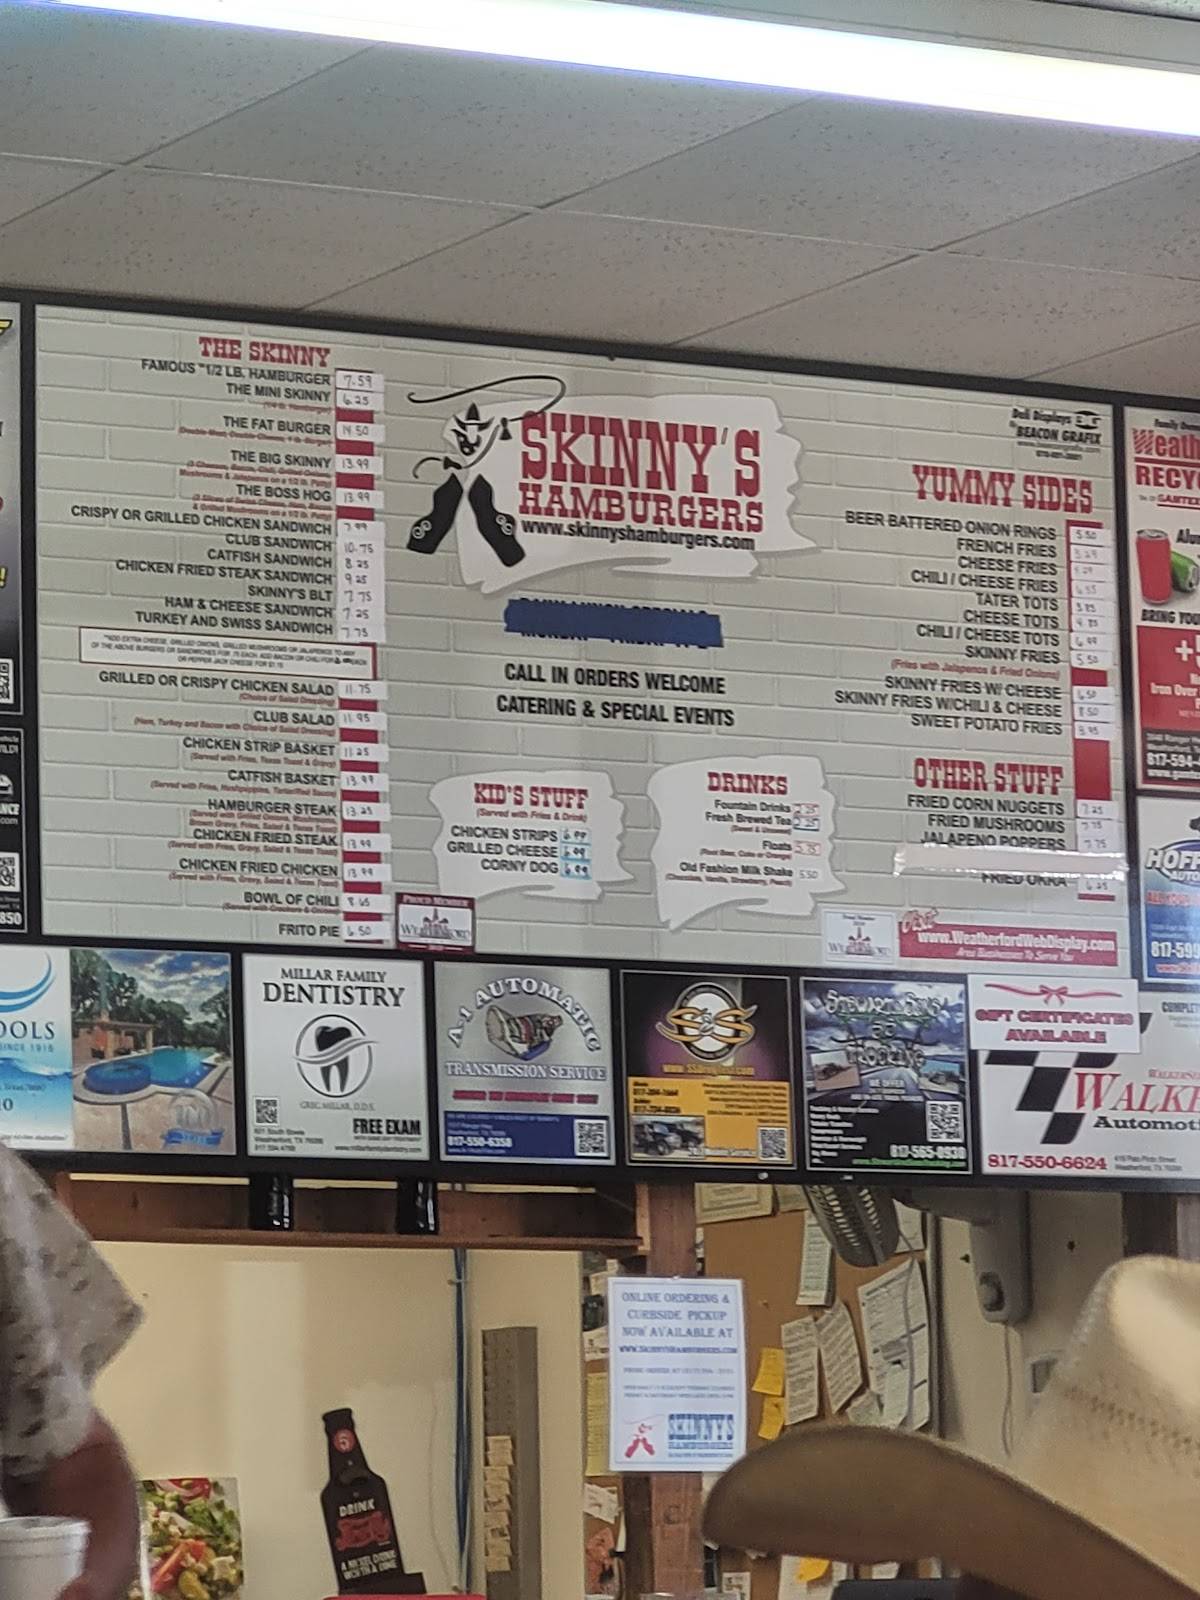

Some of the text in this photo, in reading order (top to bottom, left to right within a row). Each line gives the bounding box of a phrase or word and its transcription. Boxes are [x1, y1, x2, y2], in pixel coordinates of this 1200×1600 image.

[199, 337, 330, 367] THE SKINNY
[141, 359, 330, 386] FAMOUS HAMBURGER
[226, 383, 330, 402] THE MINI SKINNY
[223, 416, 330, 436] THE FAT BURGER
[1017, 426, 1102, 445] BEACON GRAFIX
[230, 450, 330, 468] THE BIG SKINNY
[521, 410, 761, 497] SKINNY'S
[236, 484, 331, 502] THE BOSS HOG
[912, 464, 1094, 514] YUMMY SIDES
[518, 482, 764, 533] HAMBURGERS
[71, 506, 331, 535] CRISPY OR GRILLED CHICKEN SANDWICH
[845, 511, 1056, 540] BEER BATTERED ONION RINGS
[225, 534, 331, 552] CLUB SANDWICH
[521, 518, 755, 551] www.skinnyshamburgers.com
[957, 538, 1056, 557] FRENCH FRIES
[207, 549, 331, 568] CATFISH SANDWICH
[115, 559, 332, 585] CHICKEN FRIED STEAK SANDWICH
[911, 570, 1057, 592] CHILI CHEESE FRIES
[248, 585, 332, 601] SKINNY'S BLT
[976, 593, 1058, 610] TATER TOTS
[164, 597, 332, 618] HAM CHEESE SANDWICH
[136, 612, 332, 634] TURKEY AND SWISS SANDWICH
[916, 624, 1059, 646] CHILI CHEESE TOTS
[965, 645, 1060, 664] SKINNY FRIES
[99, 671, 334, 696] GRILLED OR CRISPY CHICKEN SALAD
[504, 663, 724, 692] CALL IN ORDERS WELCOME
[885, 676, 1061, 699] SKINNY FRIES CHEESE
[497, 695, 733, 725] CATERING SPECIAL EVENTS
[835, 690, 1061, 716] SKINNY FRIES CHEESE
[911, 714, 1062, 734] SWEET POTATO FRIES
[183, 737, 334, 756] CHICKEN STRIP BASKET
[707, 771, 788, 795] DRINKS
[914, 758, 1064, 794] OTHER STUFF
[474, 783, 587, 809] KID'S STUFF
[908, 795, 1064, 814] FRIED CORN NUGGETS
[208, 799, 336, 816] HAMBURGER STEAK
[714, 800, 794, 813] Fountain Drinks
[705, 812, 794, 826] Fresh Brewed Tea
[928, 814, 1064, 833] FRIED MUSHROOMS
[451, 826, 561, 842] CHICKEN STRIPS
[1000, 835, 1066, 850] POPPERS
[447, 842, 562, 858] GRILLED CHEESE
[763, 840, 792, 852] Floats
[179, 858, 337, 876] CHICKEN FRIED CHICKEN
[481, 859, 558, 874] CORNY DOG
[679, 862, 792, 876] Old Fashion Milk Shake
[244, 892, 338, 906] BOWL OF CHILI
[278, 923, 339, 937] FRITO PIE
[281, 968, 386, 984] MILLAR FAMILY
[262, 981, 405, 1007] DENTISTRY
[448, 976, 602, 1052] A-1 AUTOMATIC
[975, 1009, 1135, 1027] GIFT CERTIFICATES
[1004, 1027, 1108, 1045] AVAILABLE
[445, 1061, 608, 1081] TRANSMISSION SERVICE
[352, 1117, 422, 1136] FREE EXAM
[987, 1153, 1108, 1171] 817-550-6624
[622, 1291, 719, 1303] ONLINE ORDERING
[627, 1309, 727, 1321] CURBSIDE PICKUP
[622, 1326, 734, 1338] NOW AVAILABLE AT
[338, 1498, 376, 1518] DRINK
